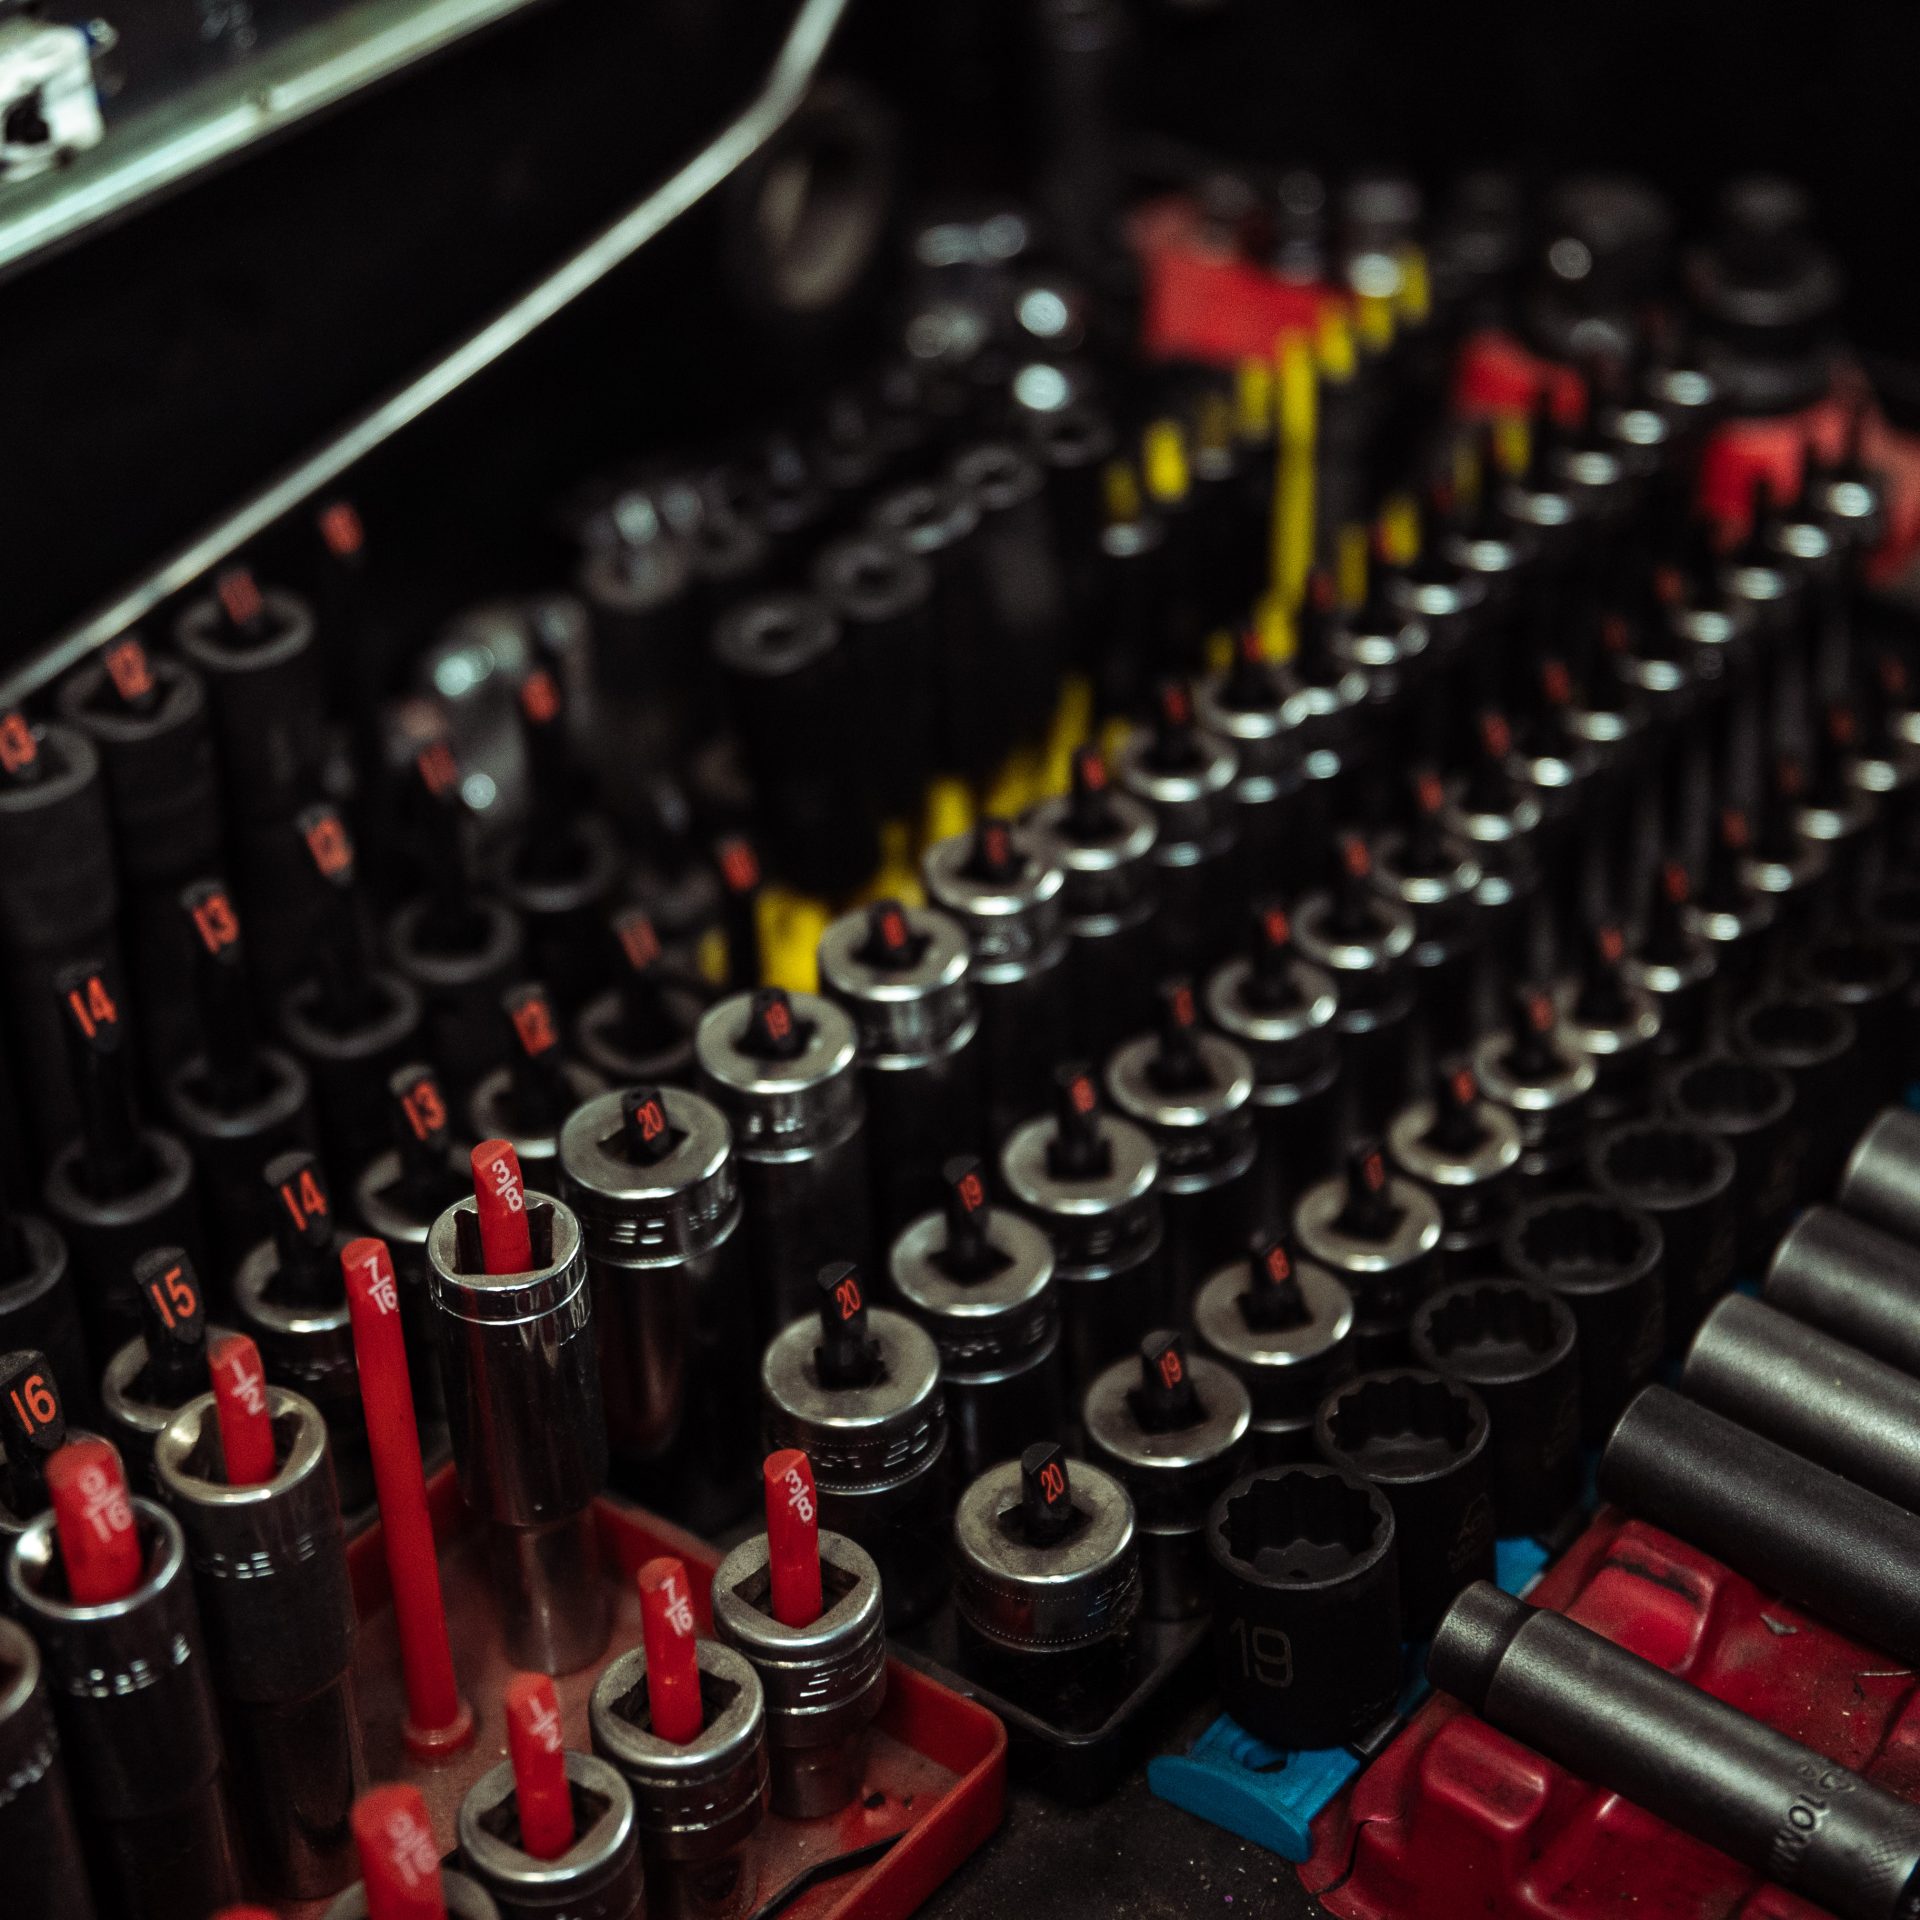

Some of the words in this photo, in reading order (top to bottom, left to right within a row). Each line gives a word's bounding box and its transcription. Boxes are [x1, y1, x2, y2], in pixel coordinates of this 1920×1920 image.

[70, 978, 117, 1037] 14
[403, 1083, 445, 1139] 13
[637, 1101, 664, 1141] 20
[282, 1170, 326, 1230] 14
[492, 1159, 523, 1212] 3/8
[150, 1266, 197, 1329] 15
[362, 1255, 400, 1316] 7/16
[835, 1279, 861, 1320] 20
[230, 1354, 267, 1417] 1/2
[1160, 1352, 1182, 1388] 19
[10, 1374, 57, 1435] 16
[785, 1469, 814, 1523] 3/8
[1041, 1463, 1065, 1504] 20
[660, 1577, 694, 1638] 7/16
[1229, 1616, 1294, 1688] 19
[529, 1696, 563, 1754] 1/2
